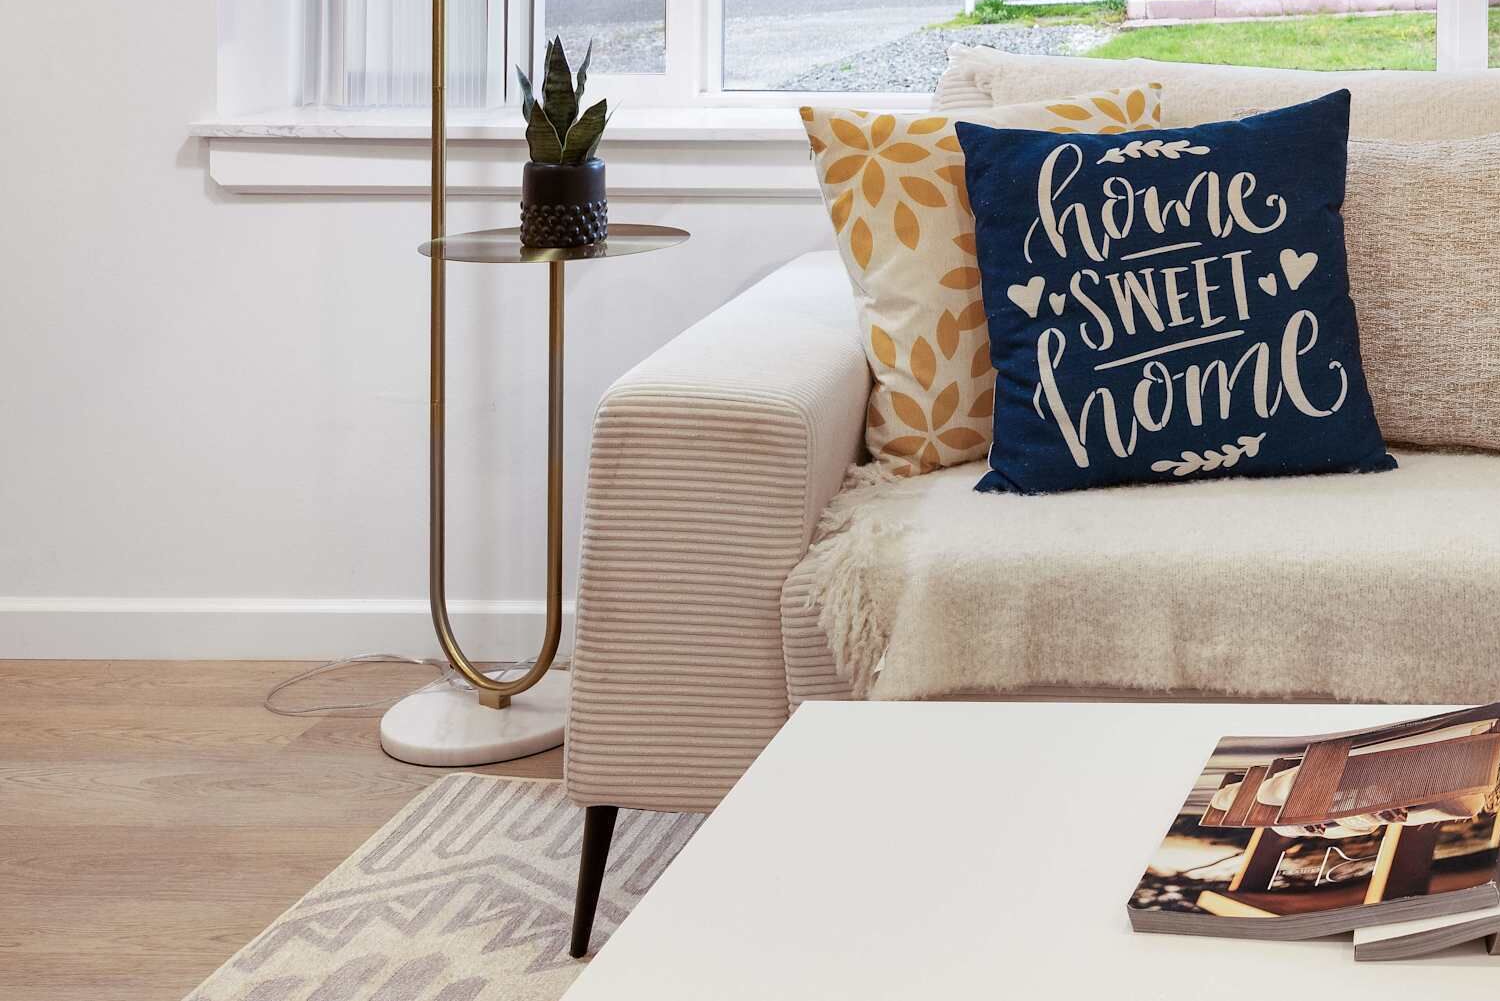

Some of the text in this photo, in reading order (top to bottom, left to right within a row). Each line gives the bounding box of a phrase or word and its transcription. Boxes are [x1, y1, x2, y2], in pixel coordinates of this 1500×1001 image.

[1024, 142, 1287, 263] home
[1070, 250, 1252, 352] SWEET
[1033, 310, 1348, 468] home
